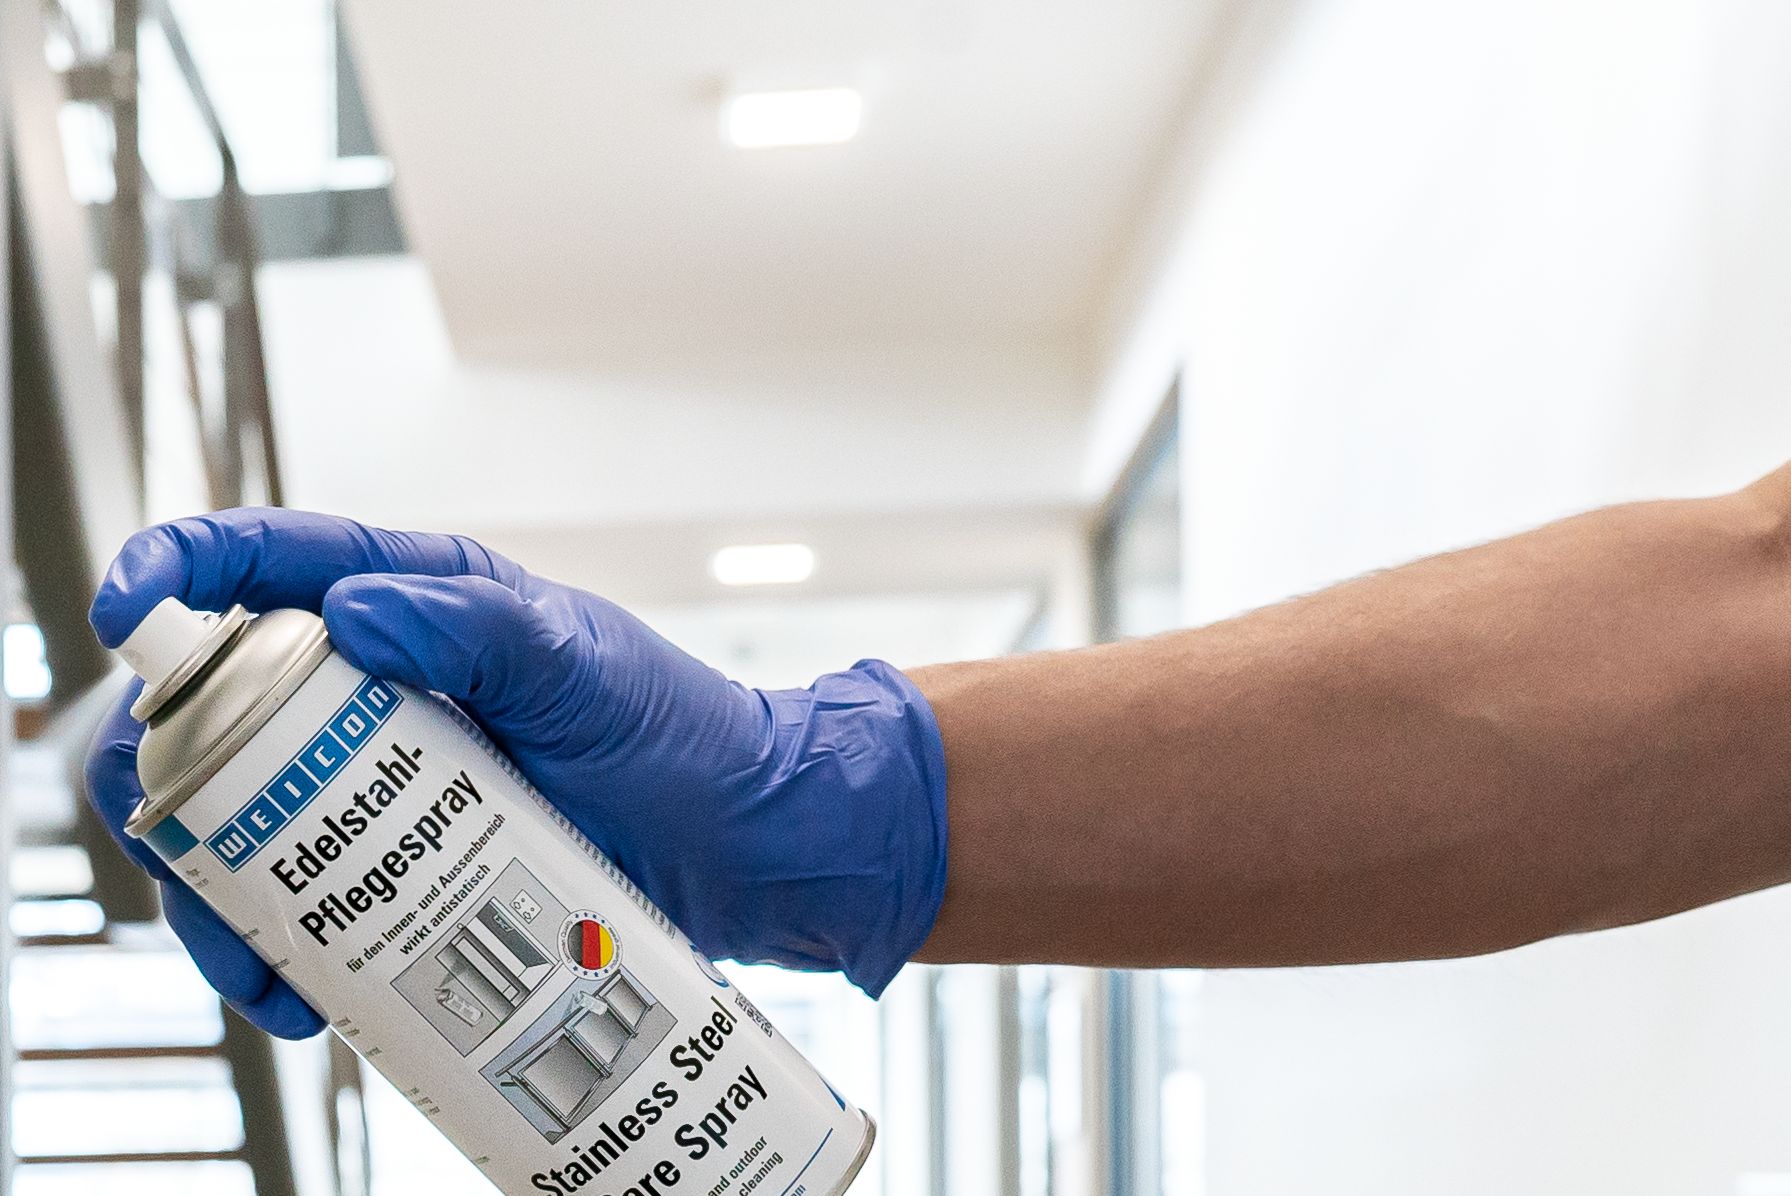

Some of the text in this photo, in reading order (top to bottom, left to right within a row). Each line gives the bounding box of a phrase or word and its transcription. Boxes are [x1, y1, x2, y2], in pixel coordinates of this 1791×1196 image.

[218, 686, 389, 858] WEICON
[270, 743, 423, 895] Edelstahl-
[298, 770, 483, 947] Pflegespray
[346, 813, 506, 973] für den Innen- und Aussenbereich
[400, 864, 491, 955] wirkt antistatisch
[670, 995, 738, 1081] Steel
[674, 1064, 768, 1160] Spray
[729, 1136, 768, 1179] outdoor
